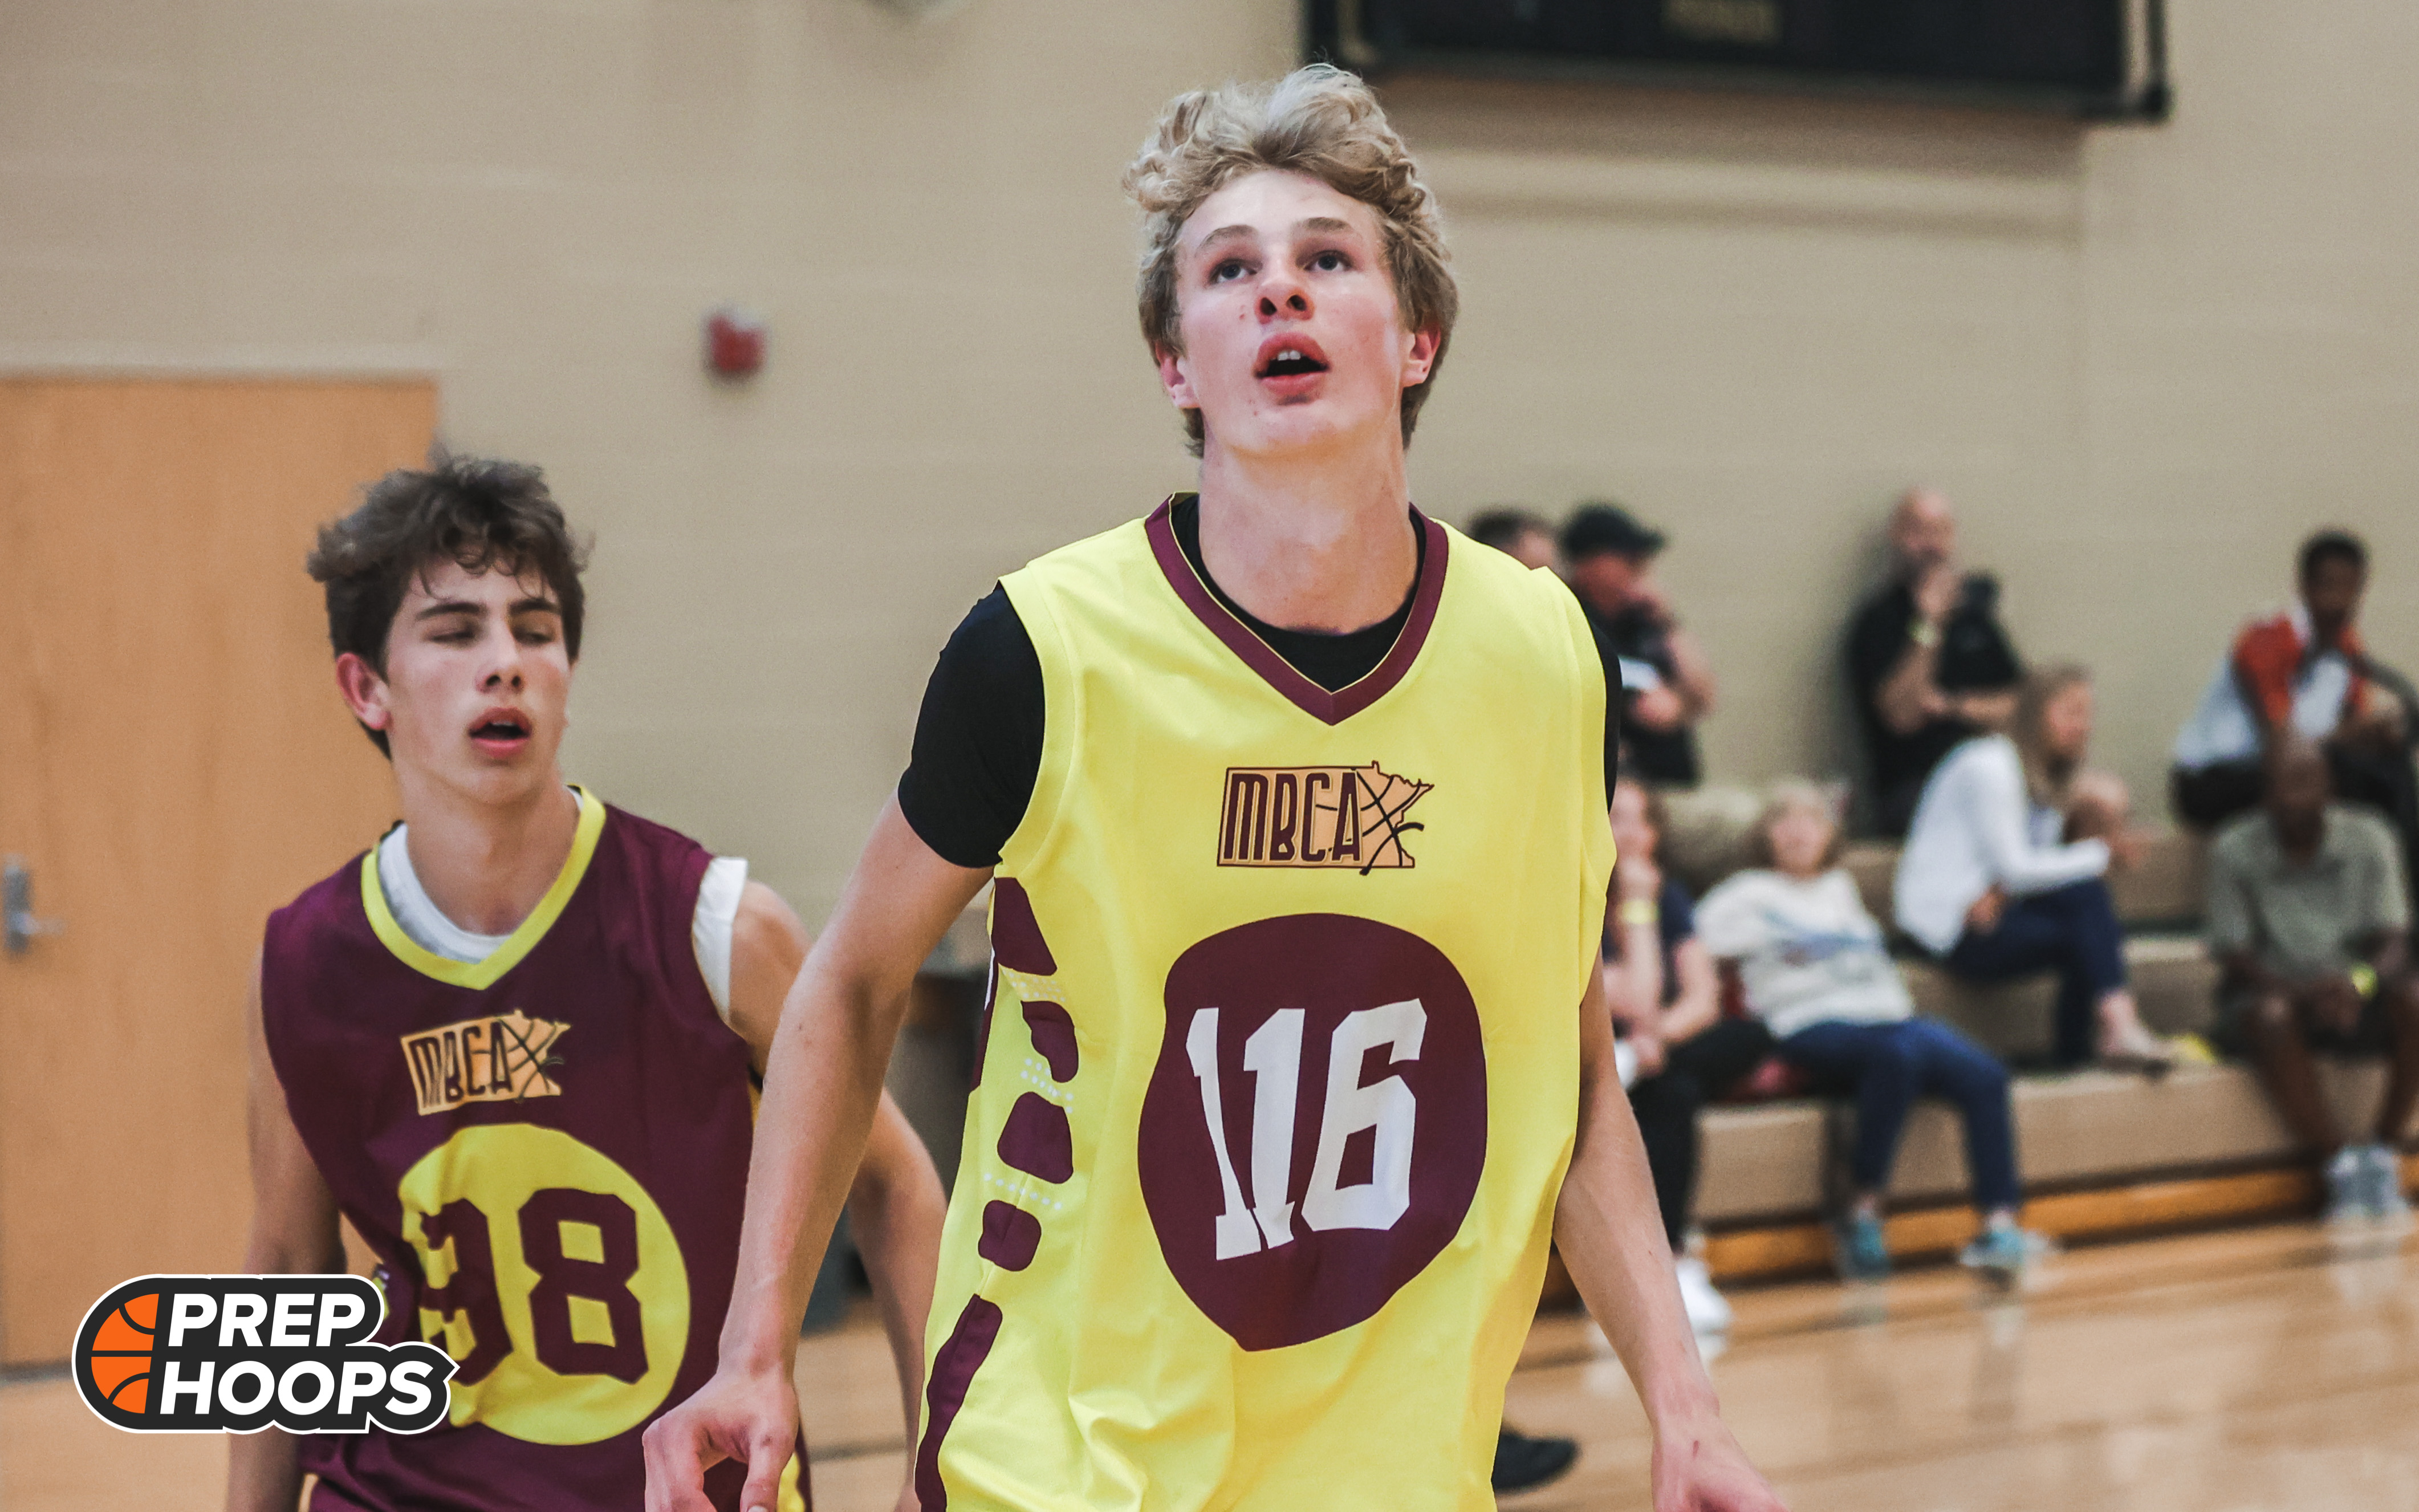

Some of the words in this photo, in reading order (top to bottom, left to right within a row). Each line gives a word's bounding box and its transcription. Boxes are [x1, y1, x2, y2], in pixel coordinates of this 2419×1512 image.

[1223, 772, 1361, 863] MBCA
[408, 1022, 513, 1108] MBCA
[1186, 998, 1427, 1261] 116
